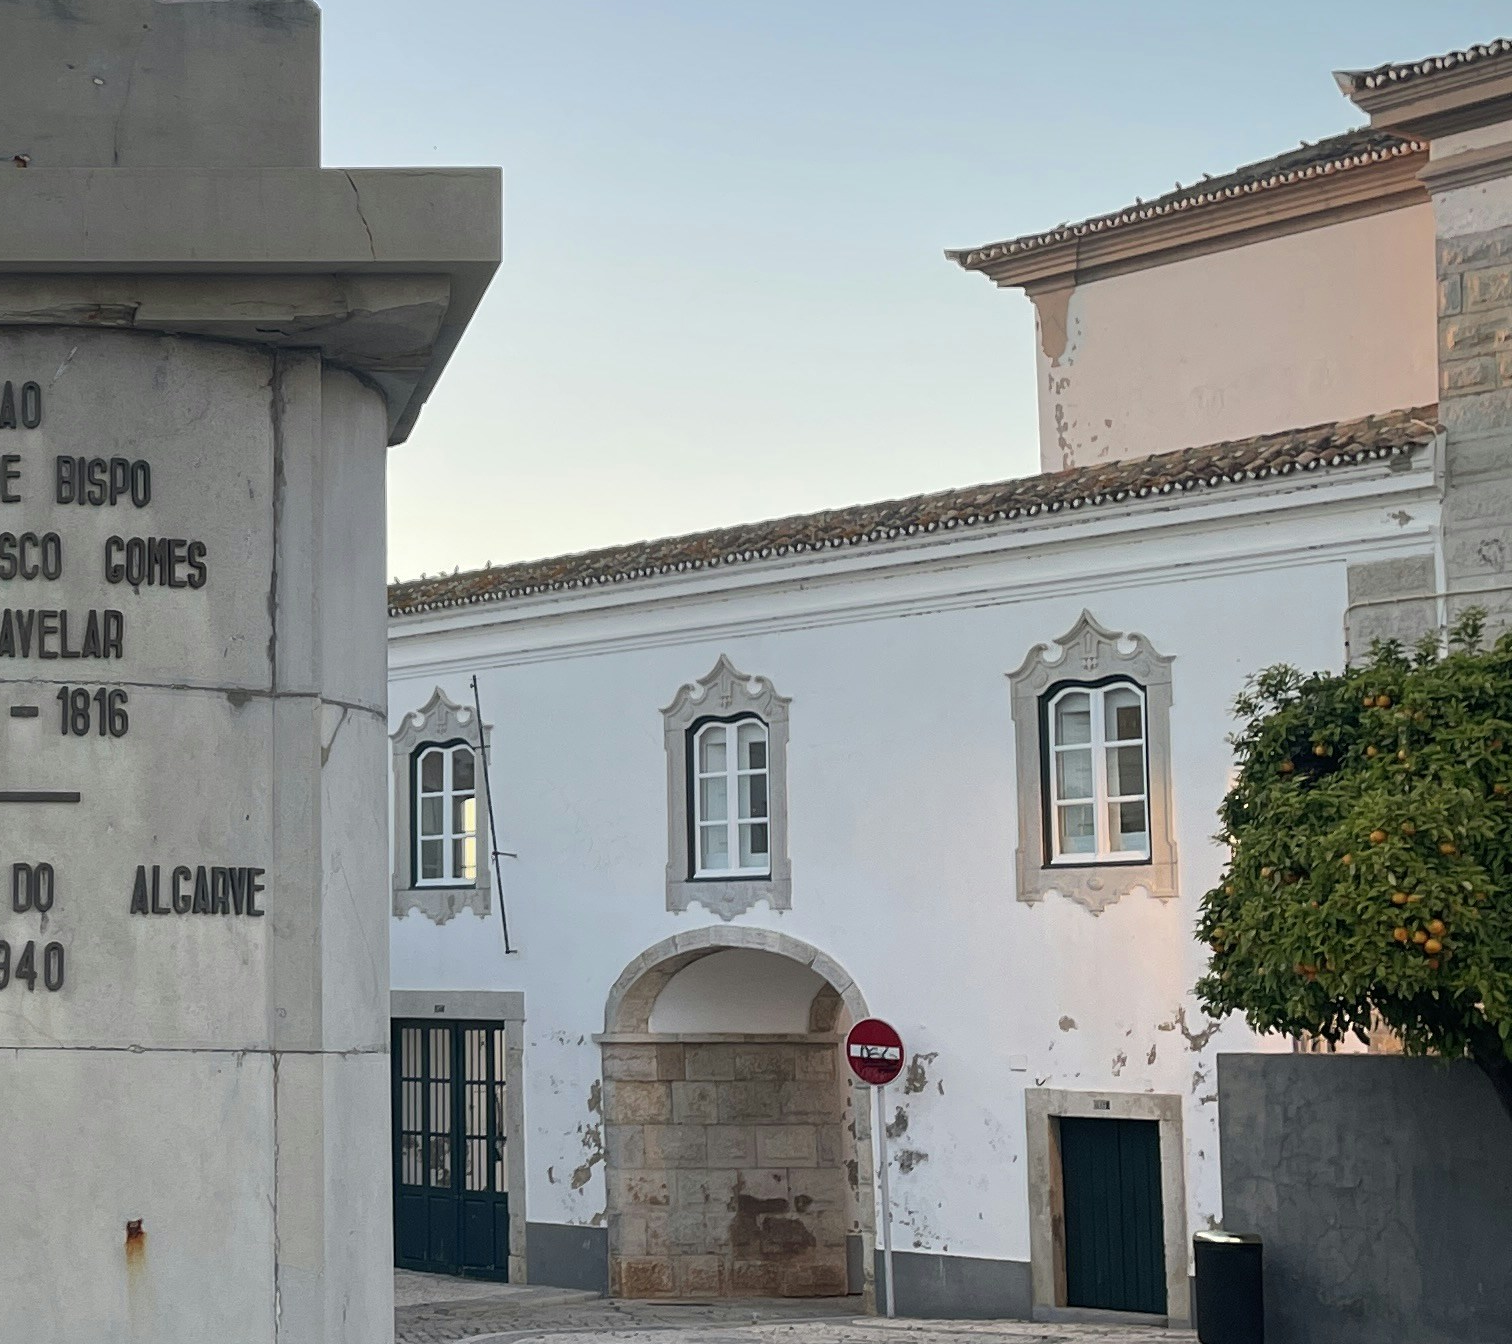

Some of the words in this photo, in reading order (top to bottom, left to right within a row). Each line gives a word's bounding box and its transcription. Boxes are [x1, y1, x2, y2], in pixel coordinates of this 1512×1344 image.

[56, 456, 151, 507] BISPO
[105, 535, 206, 587] GOMES
[57, 687, 128, 737] 1816
[13, 863, 54, 913] DO
[131, 865, 265, 916] ALGARVE
